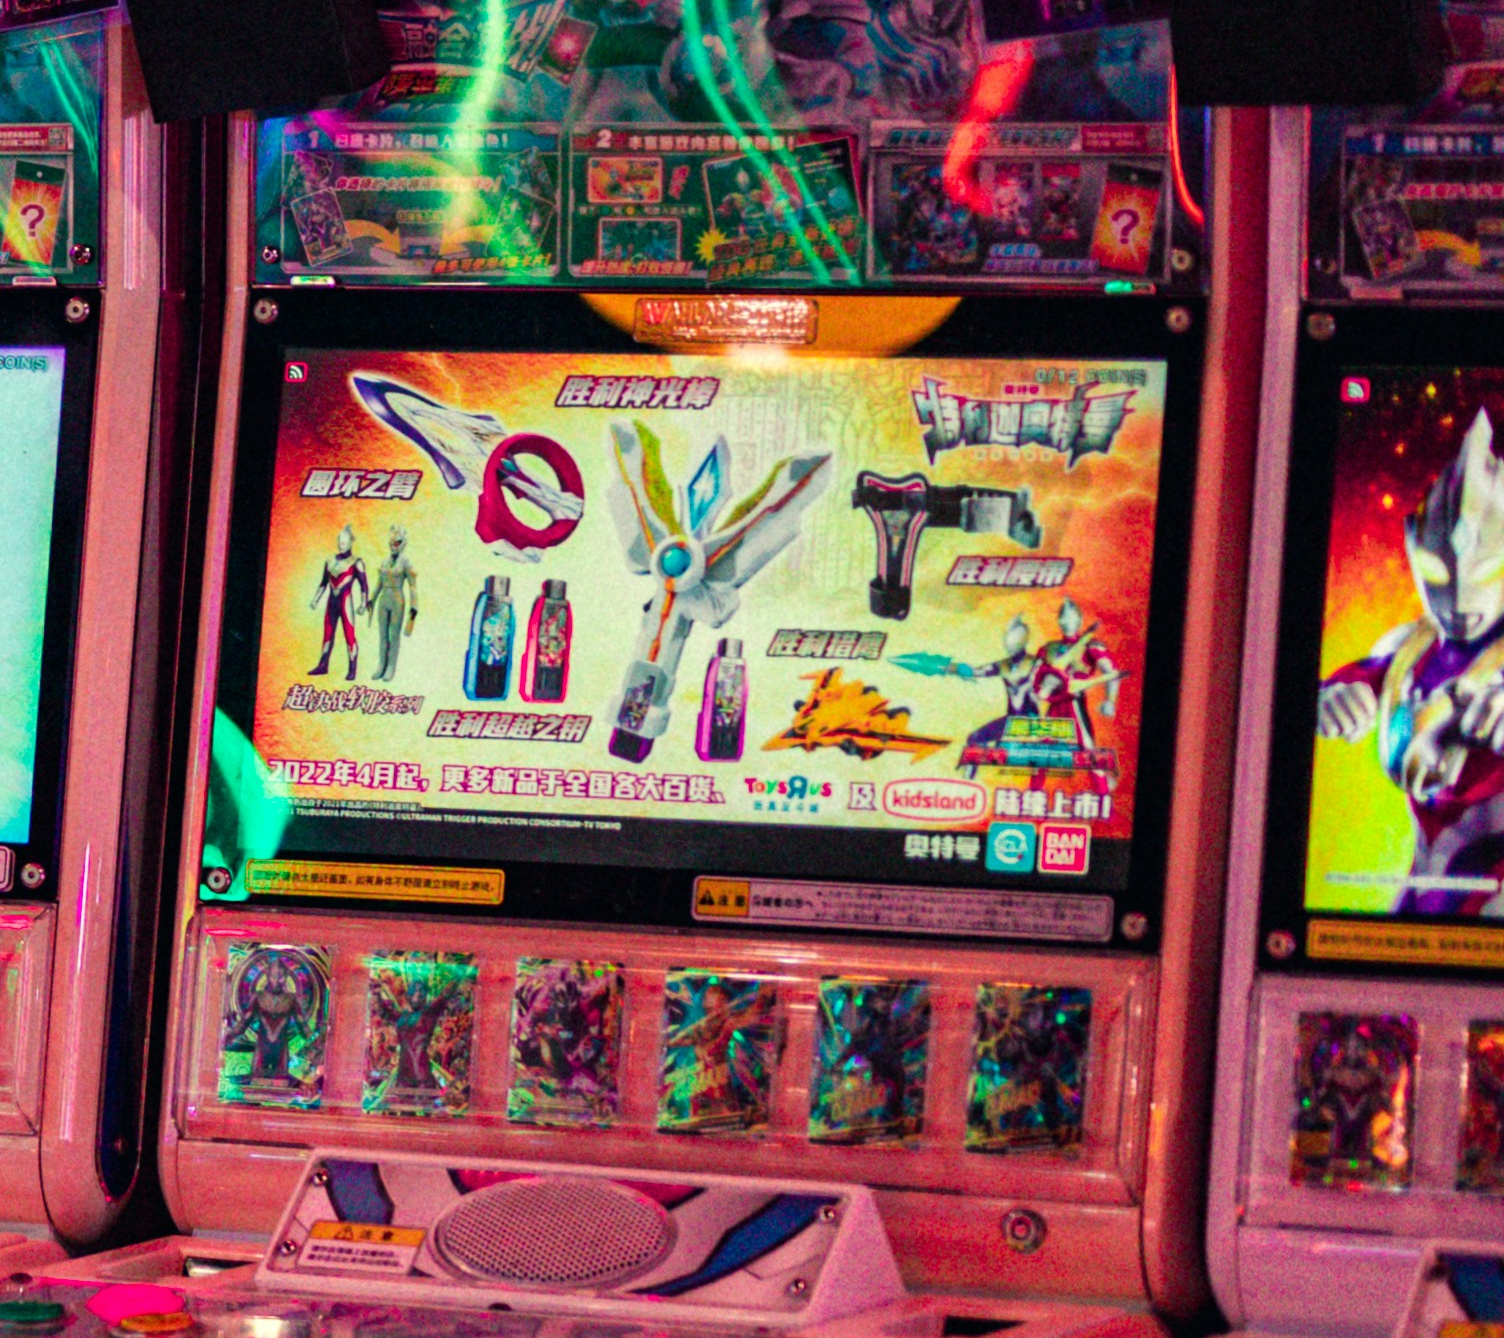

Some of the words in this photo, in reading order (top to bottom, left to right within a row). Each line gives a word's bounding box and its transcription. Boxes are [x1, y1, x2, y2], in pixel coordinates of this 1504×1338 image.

[556, 375, 720, 410] 胜利神光棒
[300, 469, 424, 500] 圆环之臂
[282, 684, 425, 717] 超决战软胶系列
[427, 710, 592, 744] 胜利超越之钥
[848, 780, 878, 812] 及
[891, 788, 977, 813] kidsland
[903, 835, 982, 862] 奥特曼
[1044, 848, 1078, 865] DAI
[1045, 835, 1083, 851] BAN
